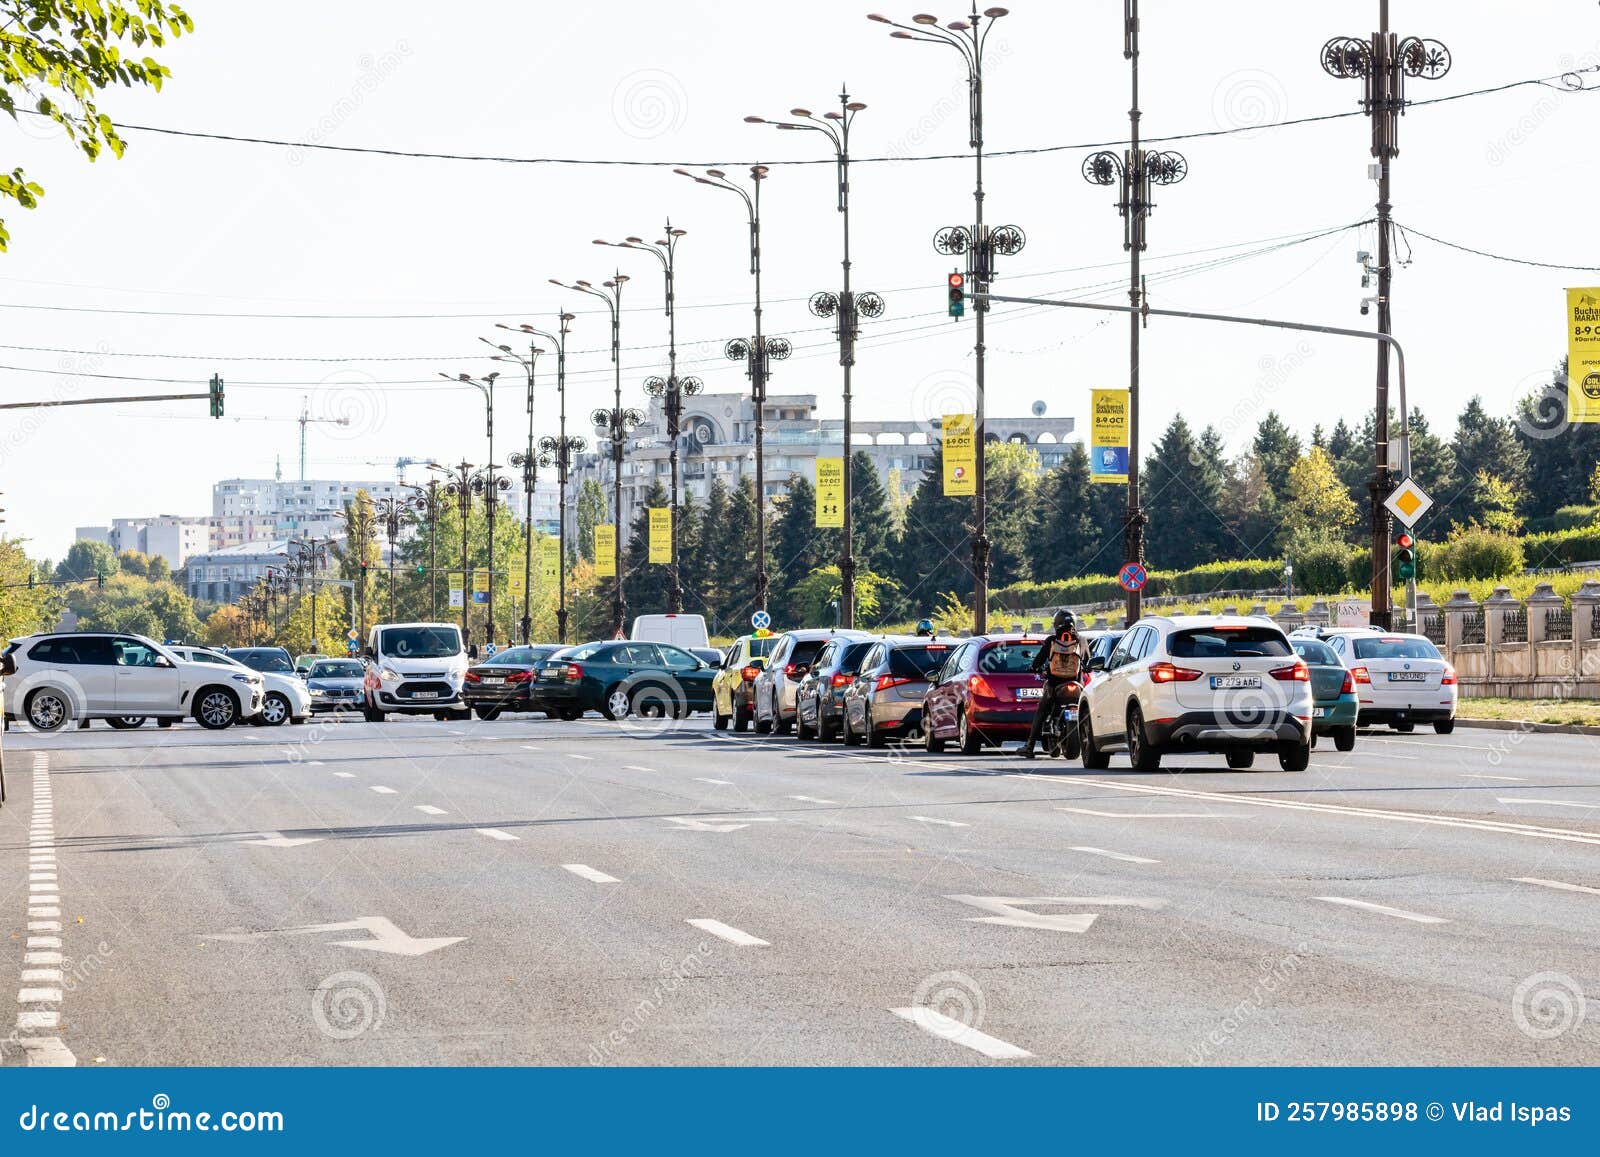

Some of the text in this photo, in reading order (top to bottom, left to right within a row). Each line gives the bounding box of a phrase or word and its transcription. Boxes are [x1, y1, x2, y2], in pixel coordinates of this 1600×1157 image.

[1575, 326, 1591, 335] 8-9
[1216, 677, 1259, 687] B 279 AAF
